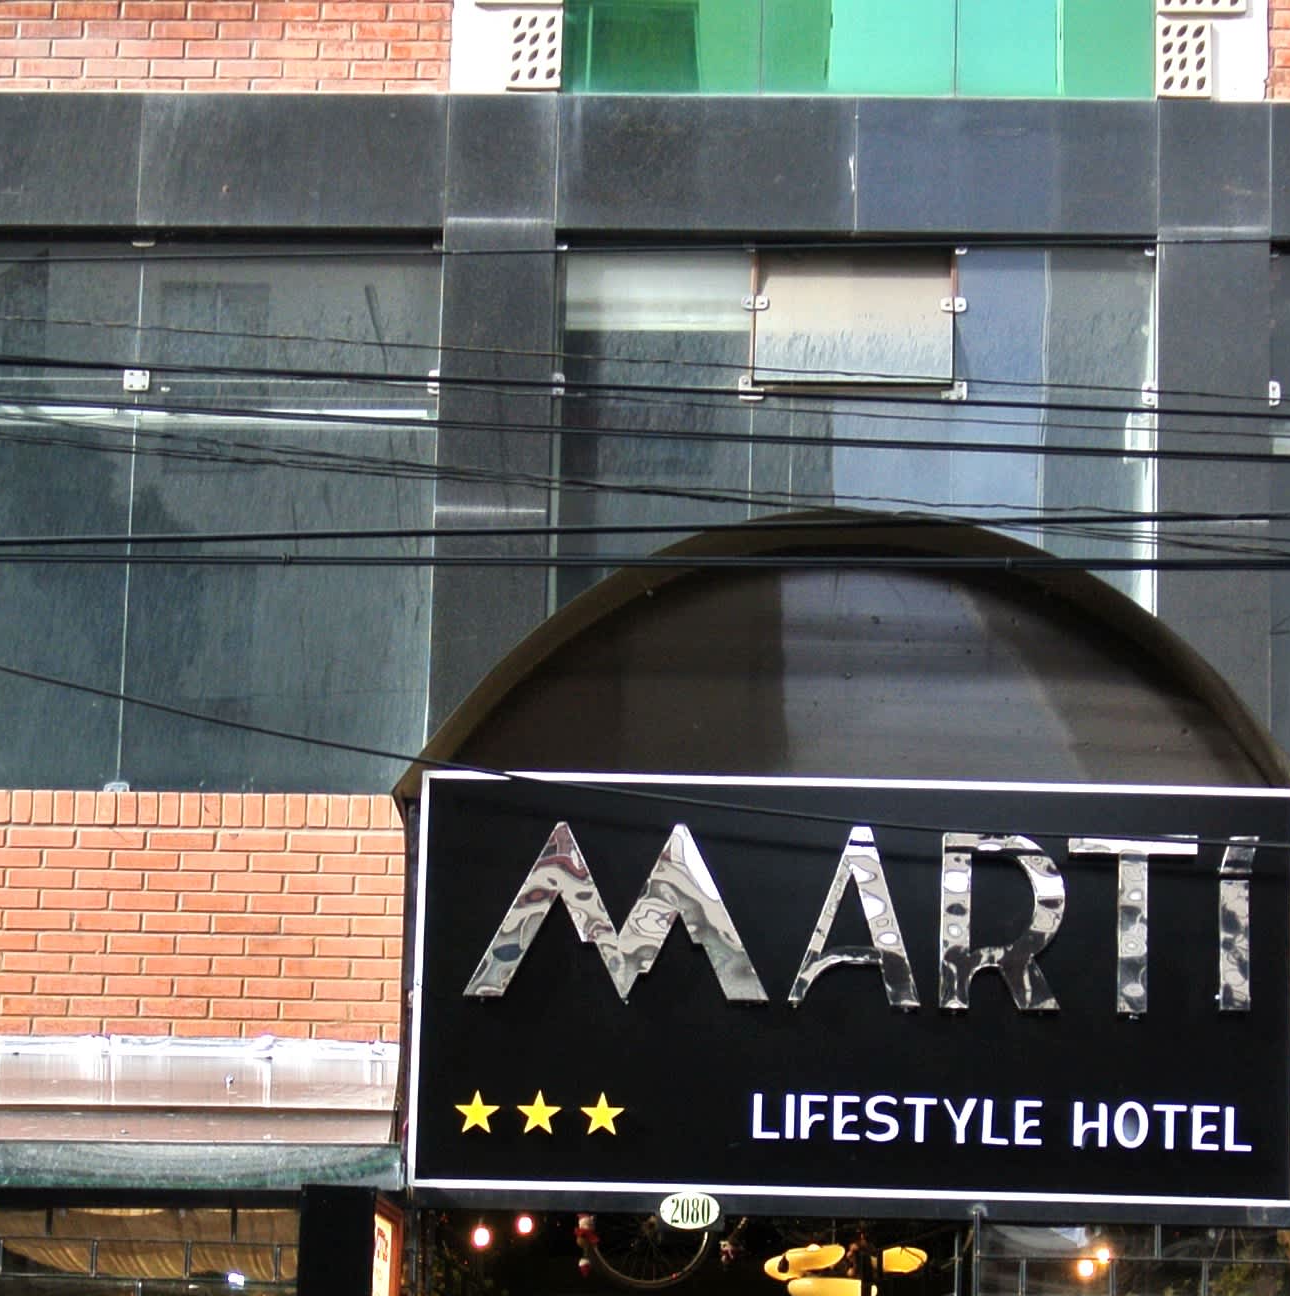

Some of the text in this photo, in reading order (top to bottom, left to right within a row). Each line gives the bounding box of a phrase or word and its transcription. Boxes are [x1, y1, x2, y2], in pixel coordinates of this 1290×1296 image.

[751, 1092, 1253, 1153] LIFESTYLE HOTEL
[670, 1197, 711, 1225] 2080
